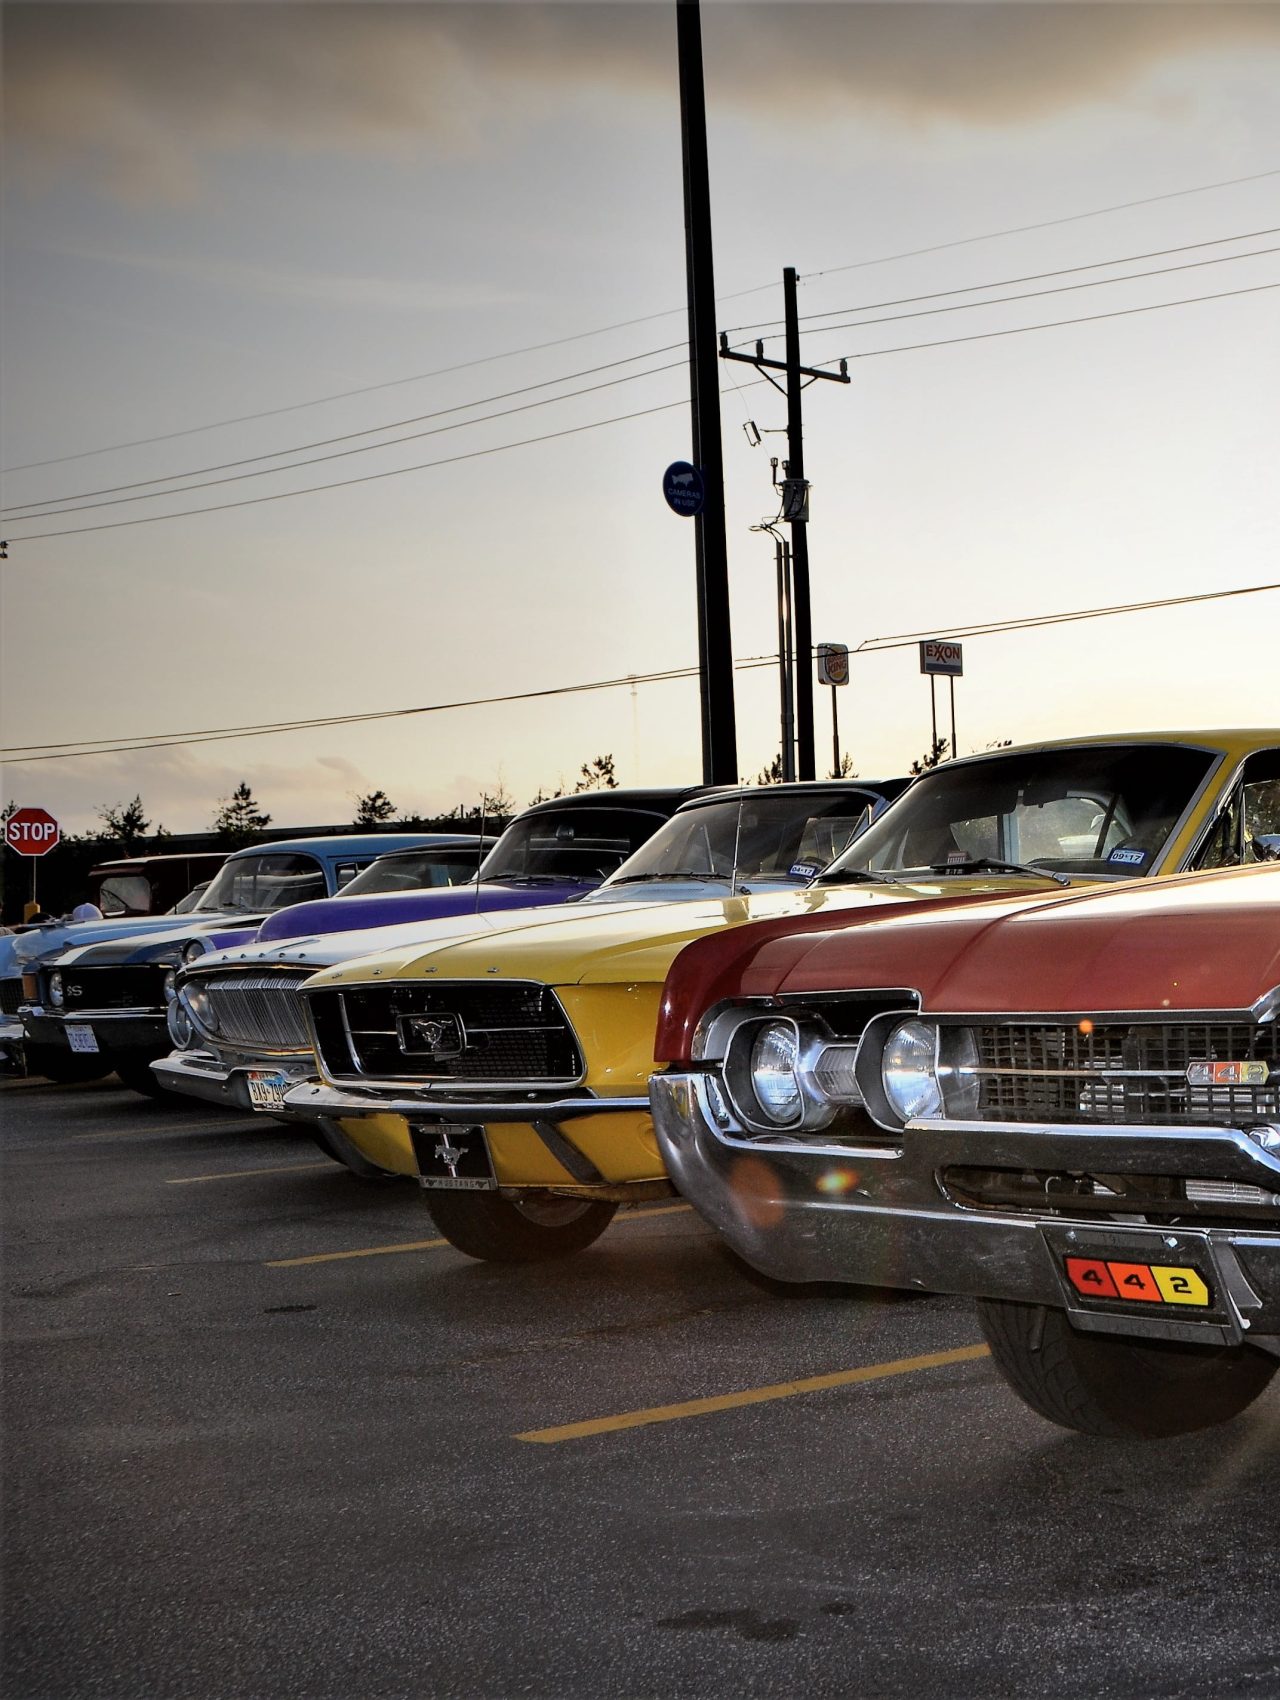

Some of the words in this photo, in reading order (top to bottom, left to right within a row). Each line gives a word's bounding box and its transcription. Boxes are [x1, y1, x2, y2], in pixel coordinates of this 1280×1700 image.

[667, 487, 702, 500] CAMERAS
[926, 644, 960, 663] EXXON
[828, 660, 846, 674] KING
[8, 822, 56, 841] STOP
[438, 1179, 475, 1188] MUSTANG
